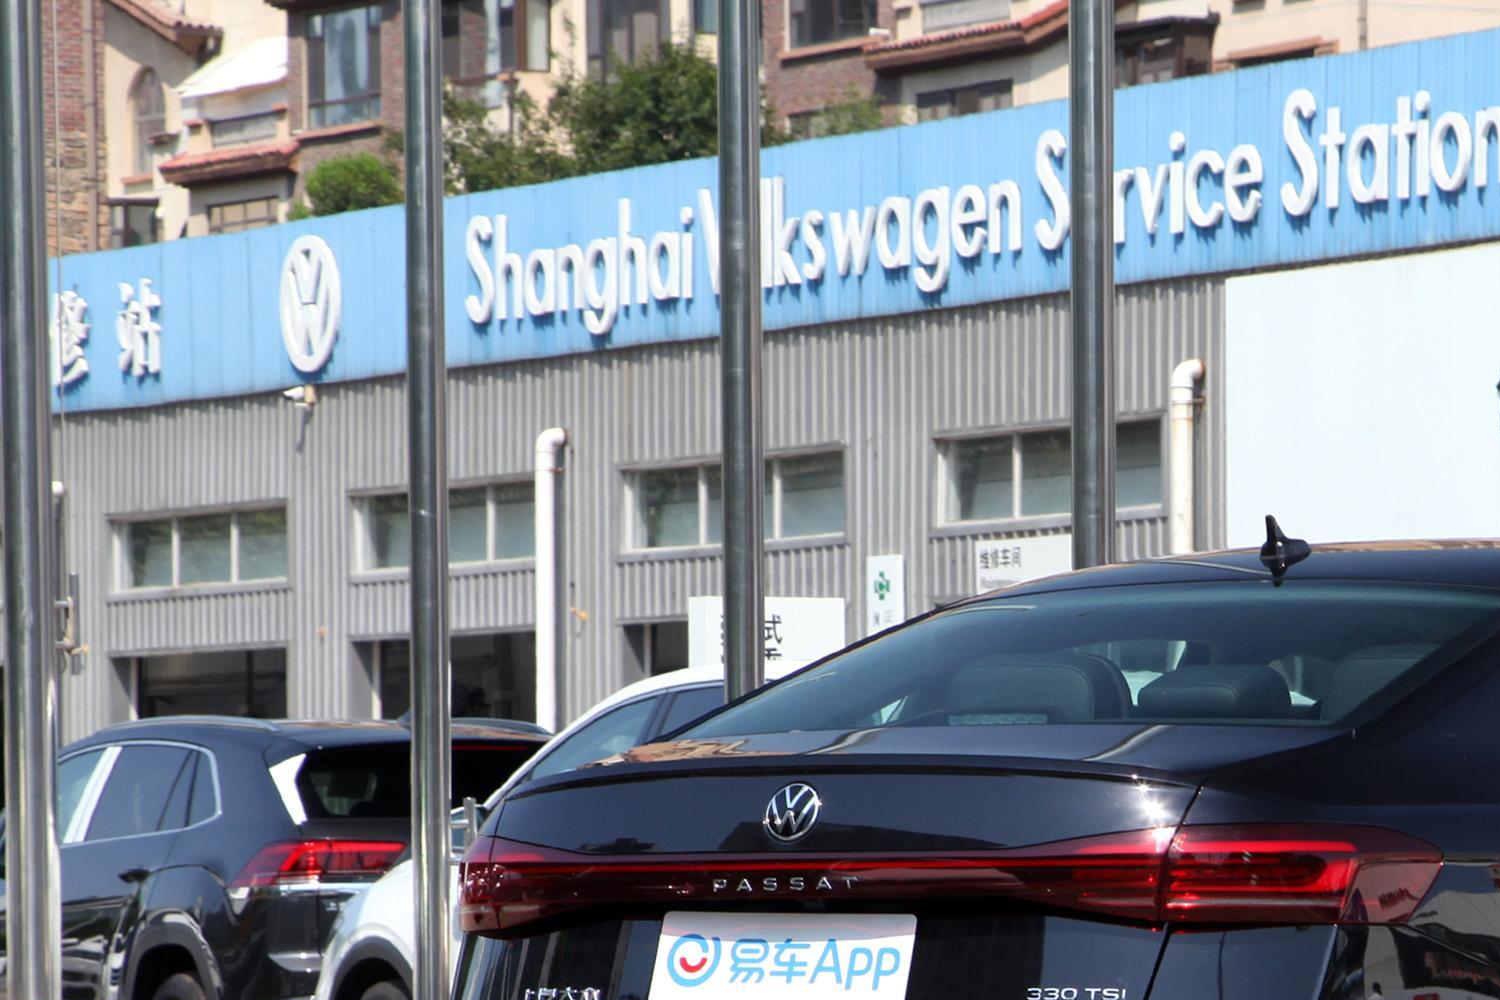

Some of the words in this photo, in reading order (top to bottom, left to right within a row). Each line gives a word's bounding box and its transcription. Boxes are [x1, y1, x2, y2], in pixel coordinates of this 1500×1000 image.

[465, 198, 693, 334] Shanghai
[698, 176, 1022, 294] Vlkswagen
[1035, 129, 1263, 250] Srvice
[712, 876, 858, 893] PASSAT
[729, 937, 901, 991] 易车App
[1026, 987, 1078, 1000] 330
[1085, 988, 1126, 1000] TSI
